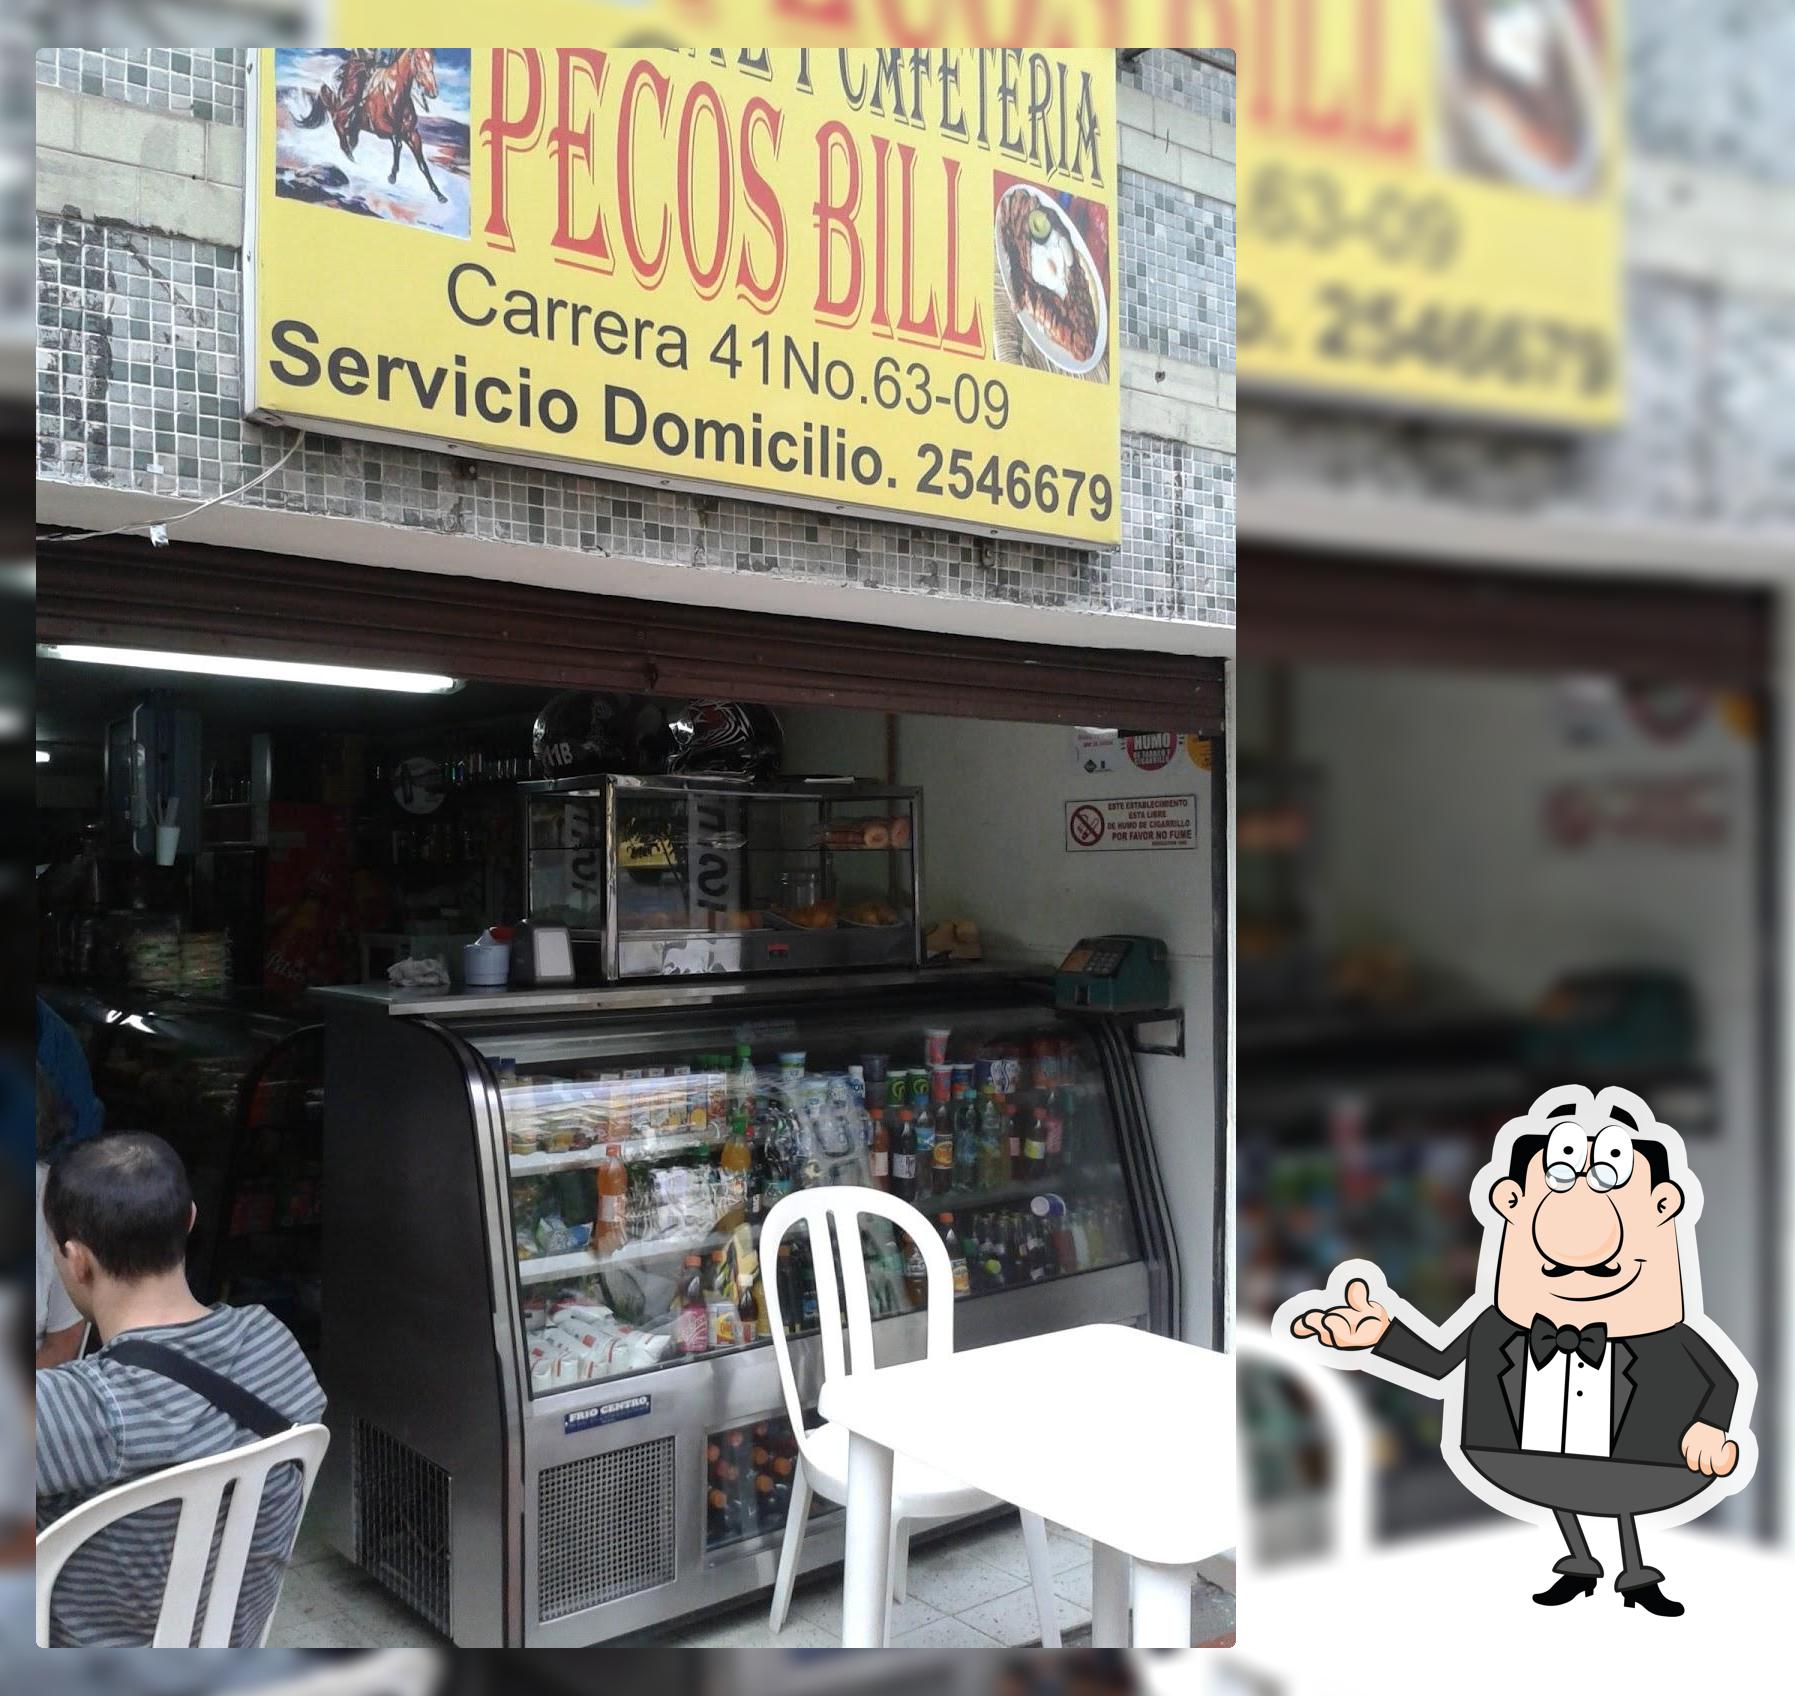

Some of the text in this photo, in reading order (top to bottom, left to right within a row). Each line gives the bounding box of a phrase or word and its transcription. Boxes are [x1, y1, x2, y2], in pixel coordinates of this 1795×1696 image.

[478, 48, 986, 360] PECOS BILL
[447, 262, 1010, 430] Carrera 41No.63-09
[269, 319, 1113, 522] Servicio Domicilio. 2546679
[1108, 799, 1188, 810] ESTE ESTABLECIMIENTO
[1118, 821, 1138, 830] HUMO
[1149, 819, 1190, 828] CIGARRILLO
[1128, 811, 1146, 820] ESTA
[1112, 829, 1192, 841] POR FAVOR NO FUME
[569, 1396, 647, 1422] FRIO CENTRO
